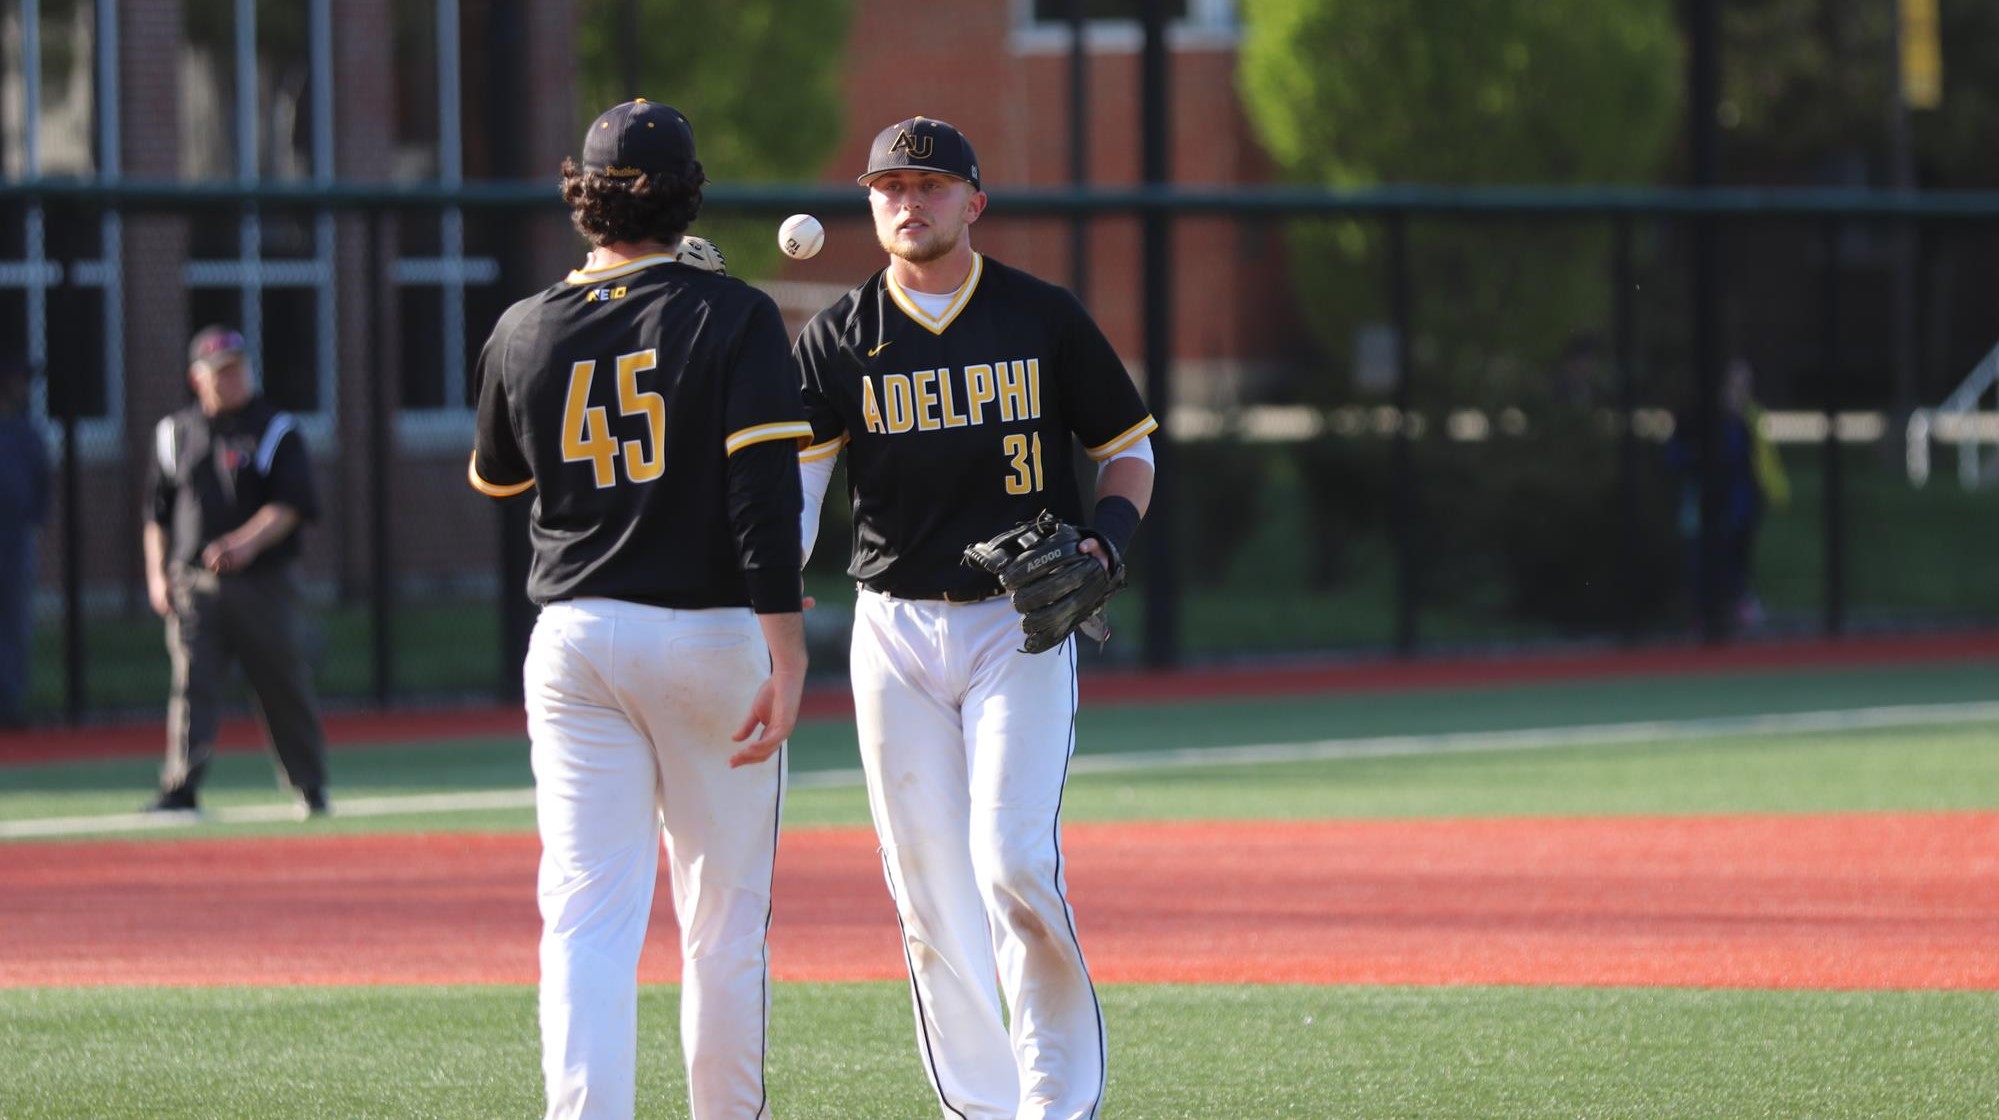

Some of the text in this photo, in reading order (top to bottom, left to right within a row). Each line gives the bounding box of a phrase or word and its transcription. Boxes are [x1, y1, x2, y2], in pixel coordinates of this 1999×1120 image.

[561, 348, 666, 489] 45
[862, 358, 1041, 434] ADELPHI
[1003, 431, 1044, 495] 31
[1026, 548, 1063, 573] A2000
